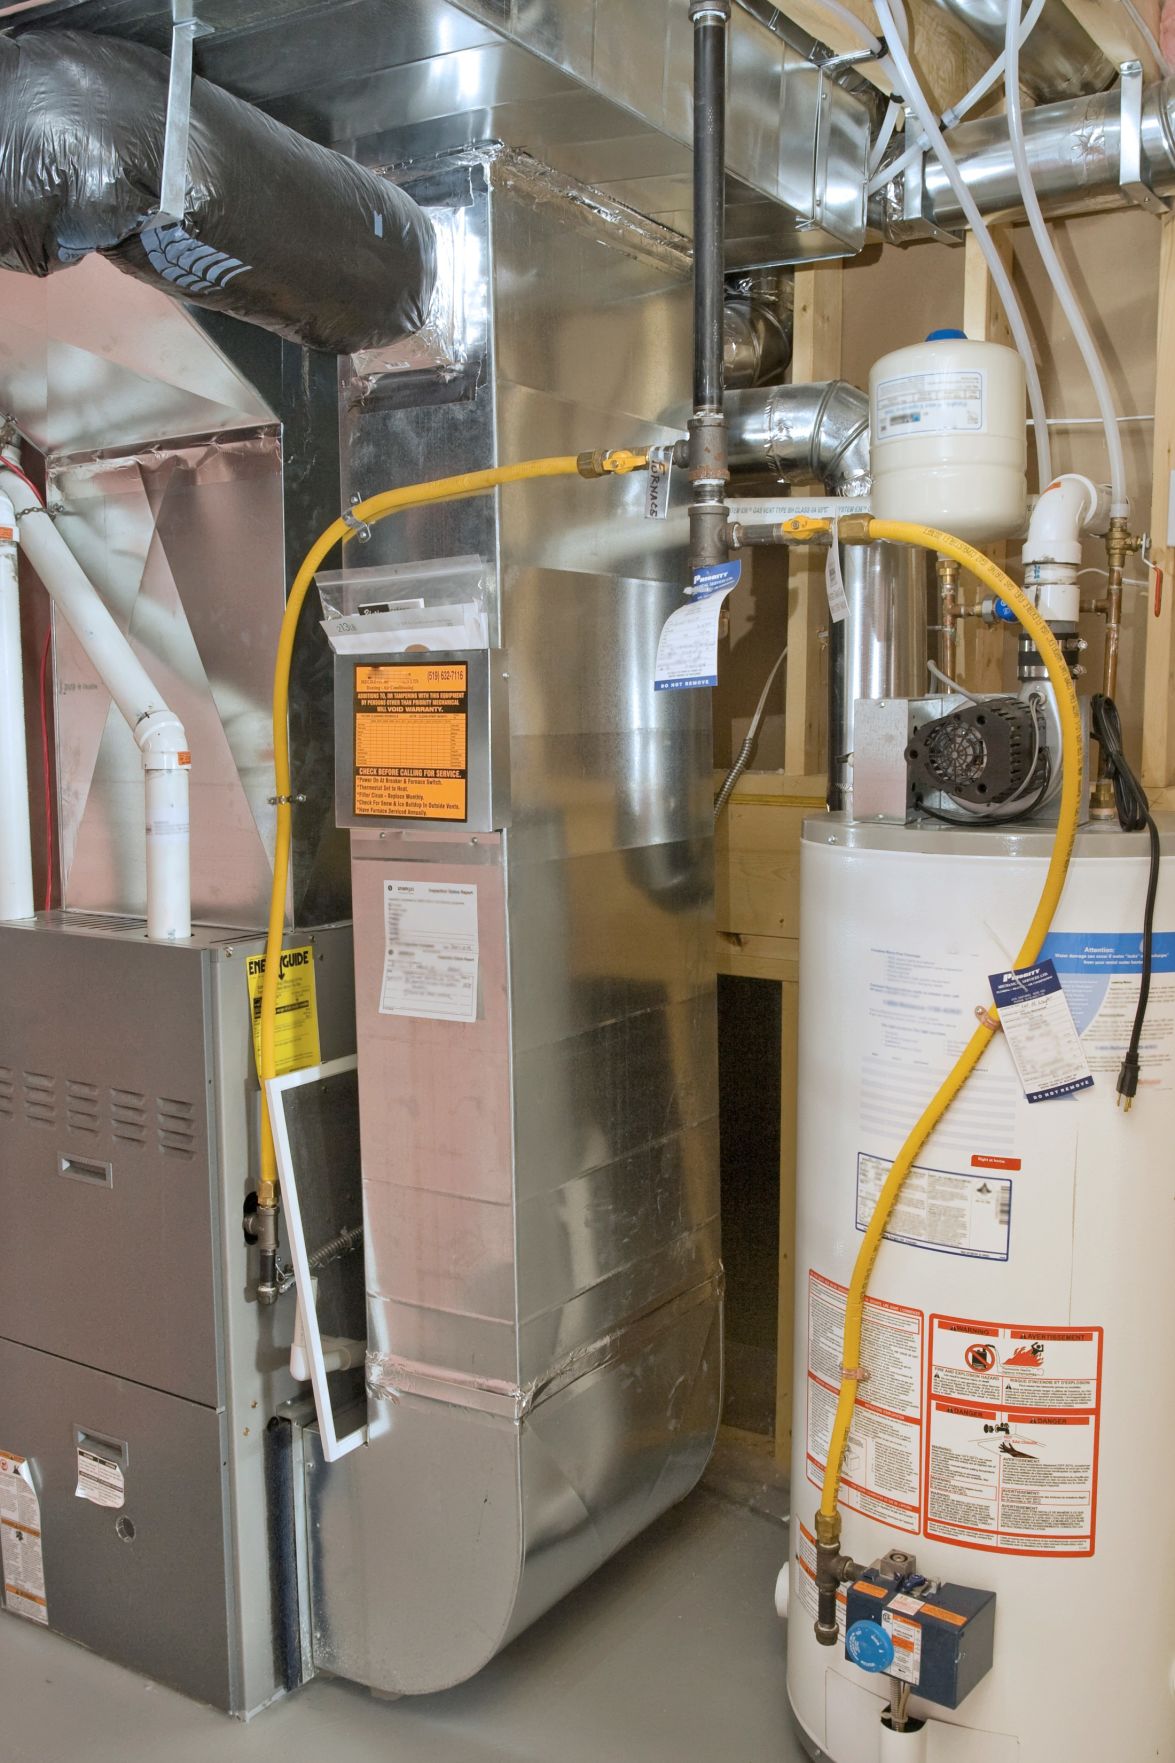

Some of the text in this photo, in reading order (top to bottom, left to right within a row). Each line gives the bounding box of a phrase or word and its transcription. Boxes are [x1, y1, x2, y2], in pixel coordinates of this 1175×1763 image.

[988, 564, 1006, 583] TUBING
[378, 768, 399, 776] BEFORE
[400, 769, 422, 777] CALLING
[436, 770, 462, 778] SERVICE.
[1033, 1080, 1089, 1100] DO NOT REMOVE
[956, 1326, 990, 1335] WARNING
[1026, 1333, 1085, 1341] AVERTISSEMENT
[954, 1408, 983, 1417] DANGER
